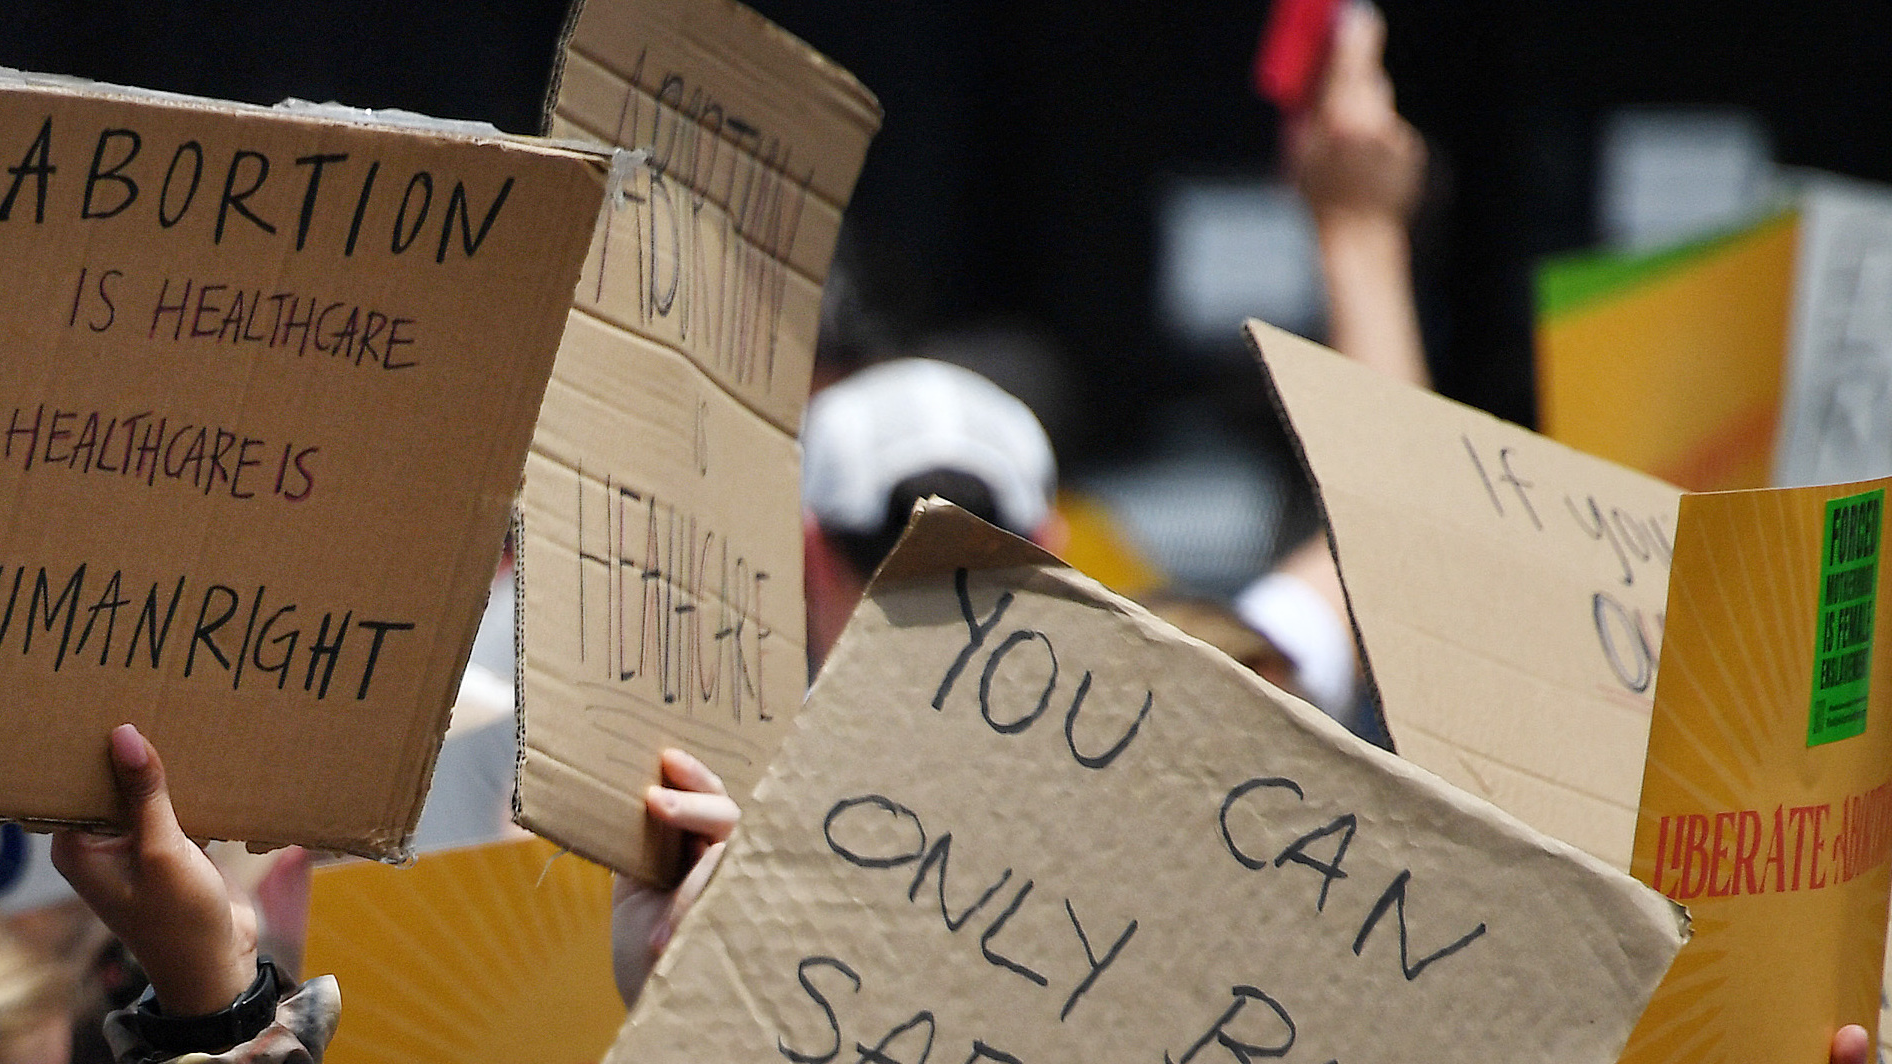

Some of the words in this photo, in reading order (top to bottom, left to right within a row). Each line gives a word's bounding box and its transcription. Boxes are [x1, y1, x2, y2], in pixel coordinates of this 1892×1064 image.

[69, 267, 117, 334] IS
[149, 278, 421, 371] HEALTHCARE
[5, 403, 265, 500] HEALTHCARE
[274, 443, 320, 503] IS
[1461, 433, 1534, 531] If
[185, 584, 416, 701] RIGHT
[931, 567, 1153, 769] YOU
[1219, 776, 1487, 982] CAN
[1652, 803, 1830, 900] LIBERATE
[823, 793, 1138, 1022] ONLY
